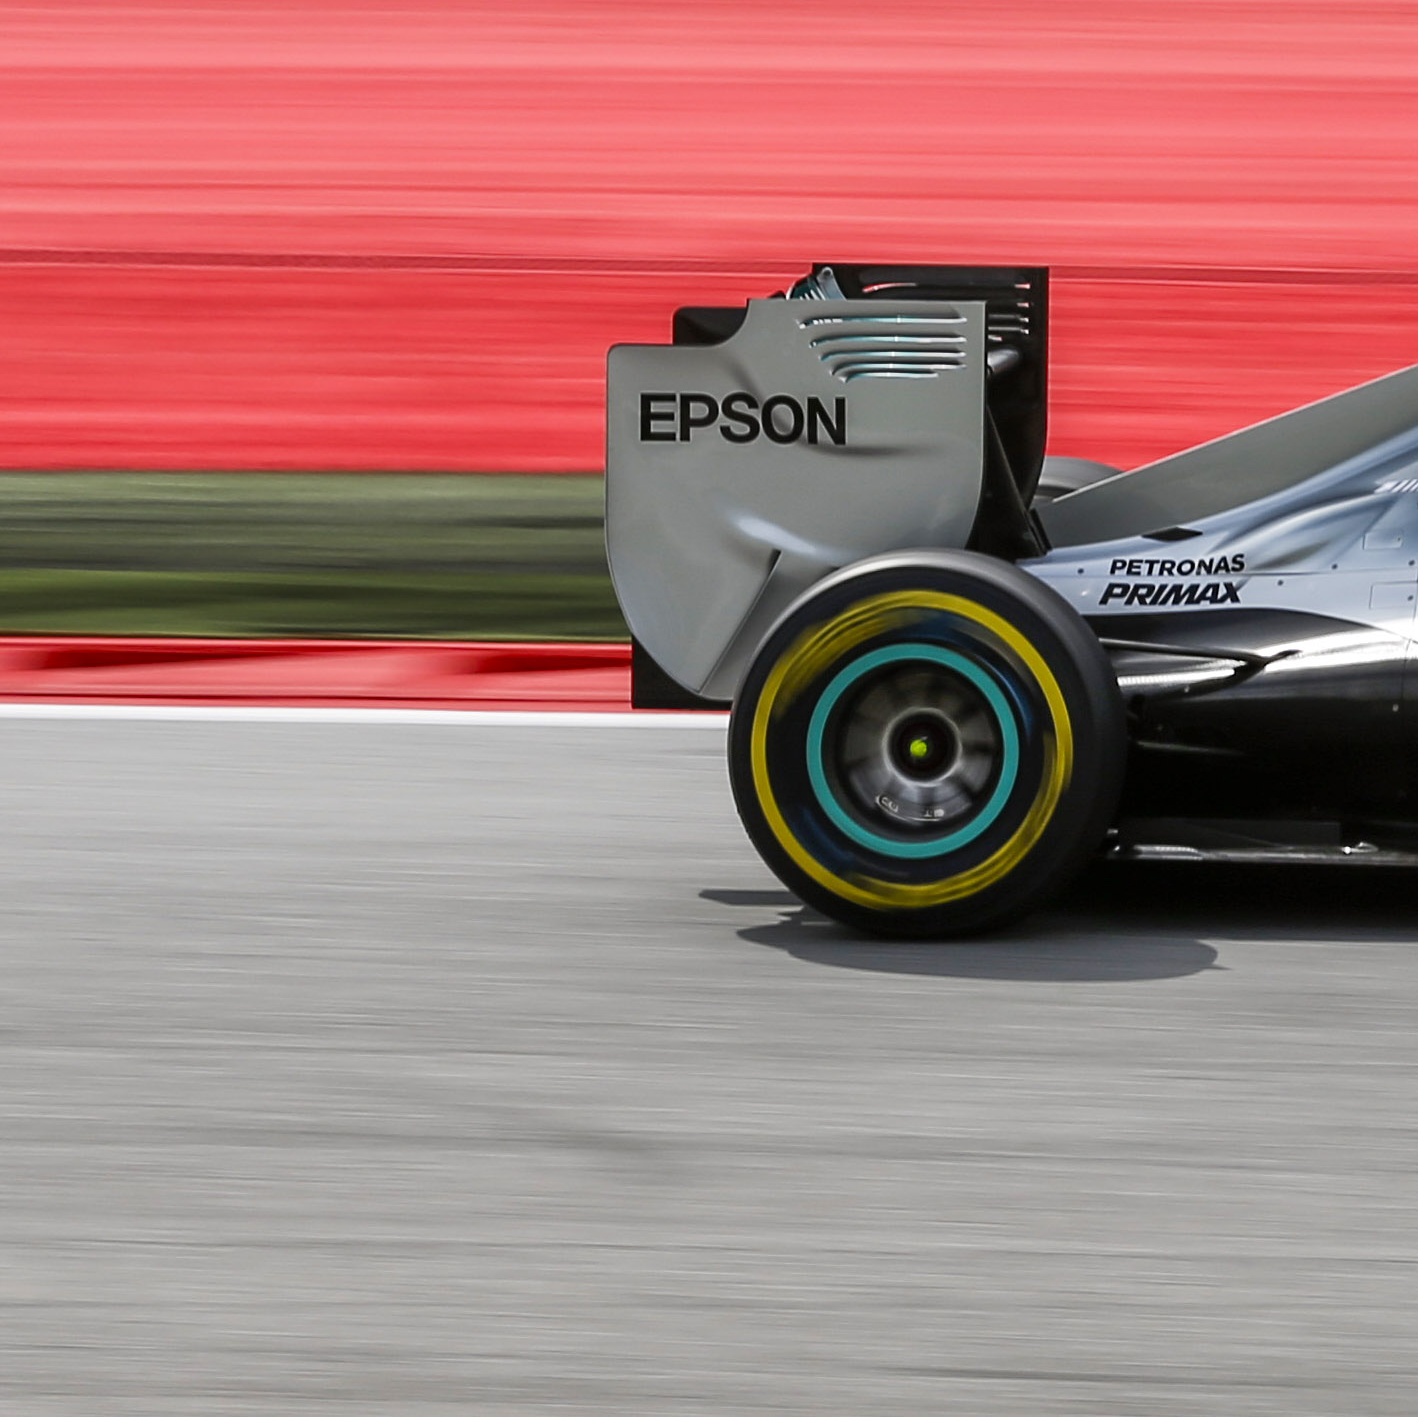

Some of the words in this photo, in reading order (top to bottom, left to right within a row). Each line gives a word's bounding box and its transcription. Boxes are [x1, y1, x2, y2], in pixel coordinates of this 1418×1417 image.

[639, 391, 847, 445] EPSON
[1109, 553, 1246, 577] PETRONAS
[1098, 581, 1241, 606] PRIMAX
